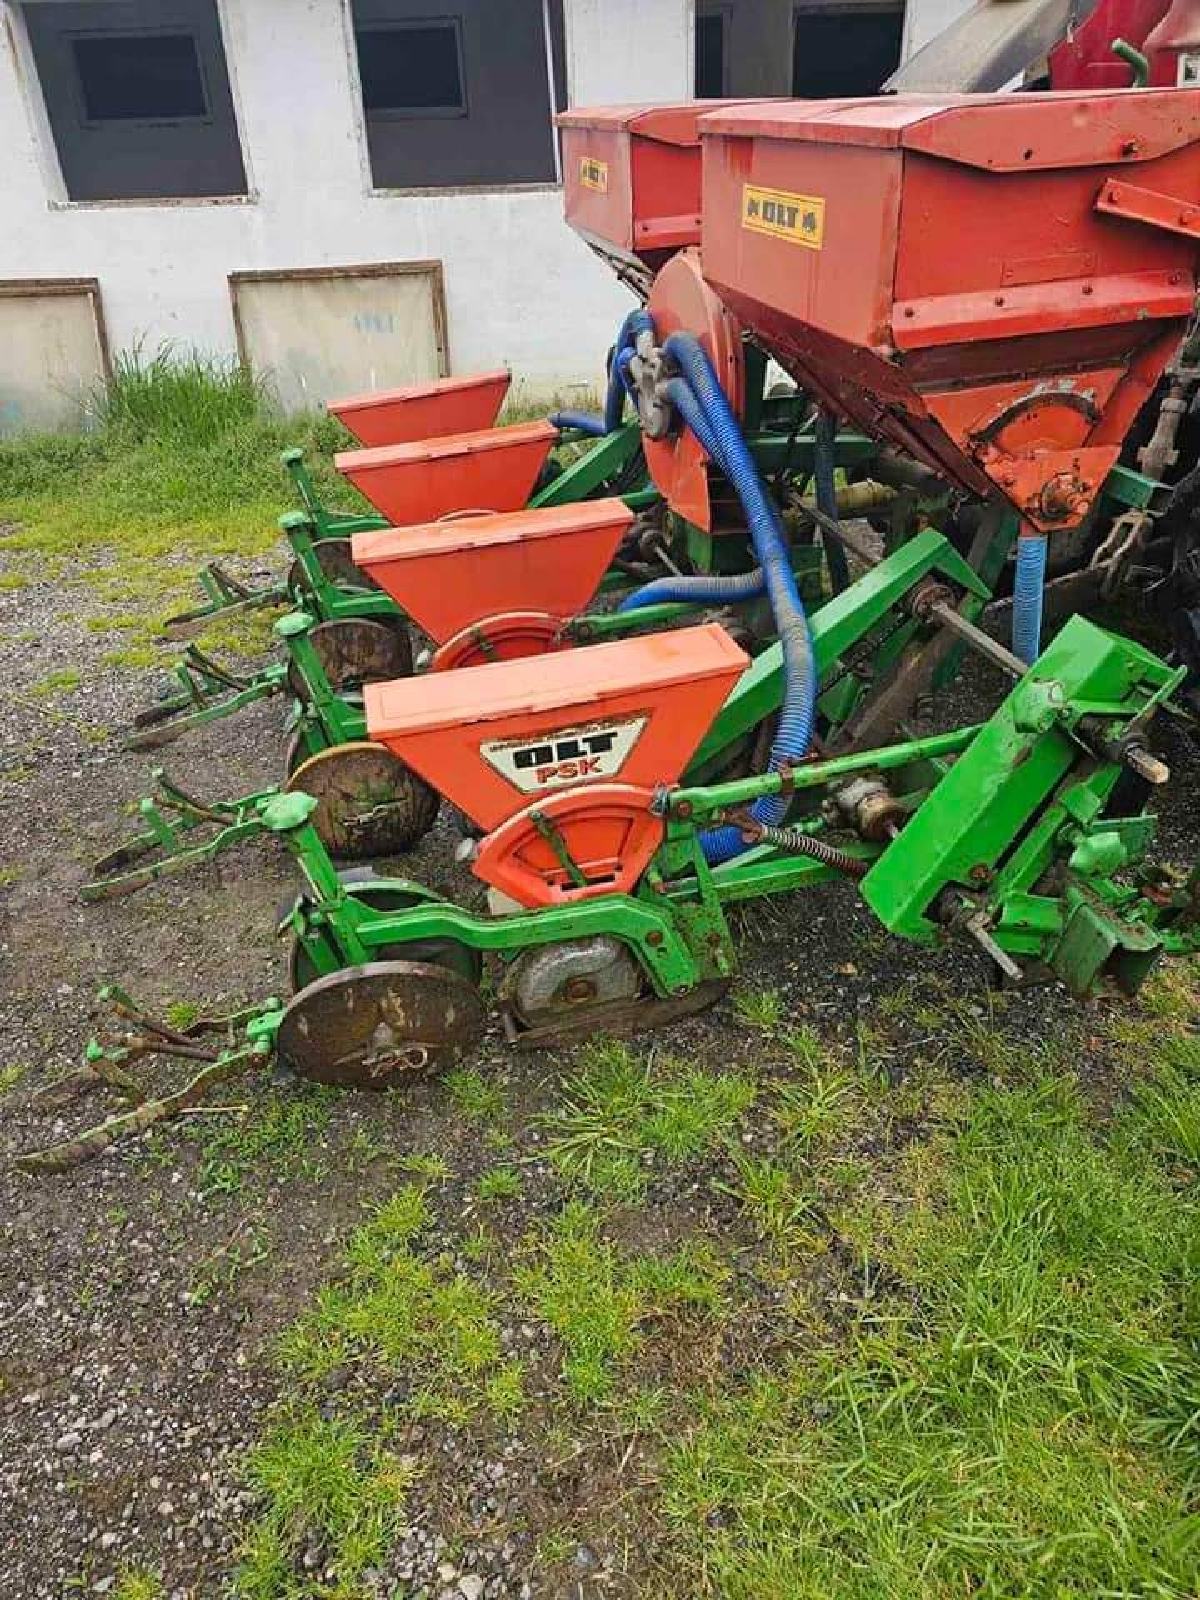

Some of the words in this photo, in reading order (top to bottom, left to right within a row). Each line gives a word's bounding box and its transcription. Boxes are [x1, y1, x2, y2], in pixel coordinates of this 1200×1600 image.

[762, 199, 799, 228] OLT
[513, 731, 618, 769] OLT
[535, 756, 603, 784] PSK
